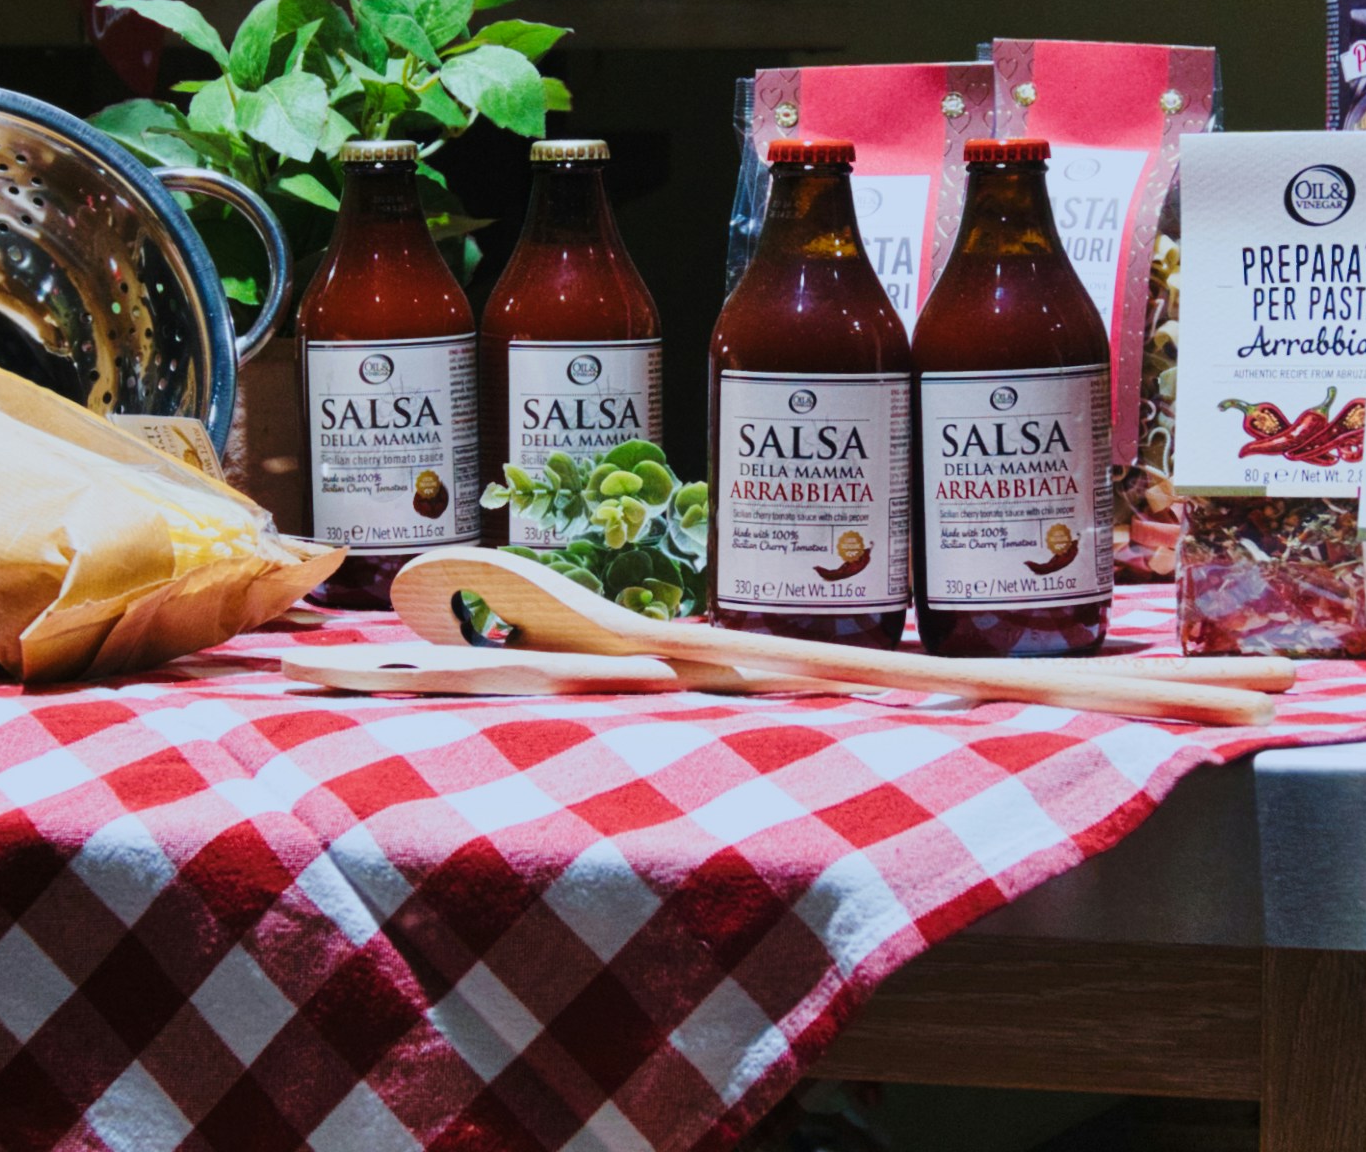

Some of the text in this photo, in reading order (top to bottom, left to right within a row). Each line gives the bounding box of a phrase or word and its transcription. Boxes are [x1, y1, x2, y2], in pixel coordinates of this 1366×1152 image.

[1295, 180, 1348, 201] OIL&
[1295, 200, 1344, 209] VINEGAR
[1051, 197, 1119, 230] STA
[1067, 237, 1113, 262] ORI
[1253, 288, 1296, 321] PER
[1233, 370, 1277, 378] AUTHENTIC
[1280, 370, 1308, 378] RECIPE
[1311, 370, 1333, 378] FROM
[321, 396, 441, 430] SALSA
[523, 396, 641, 430] SALSA
[321, 432, 441, 446] DELLA MAMMA
[522, 434, 570, 446] DELLA
[739, 424, 868, 460] SALSA
[942, 420, 1073, 458] SALSA
[321, 452, 443, 466] Sicilian cherry tomato sauce
[740, 462, 865, 478] DELLA MAMMA
[945, 460, 1069, 476] DELLA MAMMA
[357, 473, 381, 482] 100%
[1245, 469, 1259, 482] 80
[1263, 472, 1270, 484] g
[1301, 470, 1320, 482] Net
[1325, 470, 1343, 482] Wt.
[347, 484, 372, 495] Cherry
[375, 483, 408, 493] Tomatoes
[730, 480, 875, 502] ARRABBIATA
[936, 476, 1079, 500] ARRABBIATA
[753, 510, 771, 521] cherry
[772, 511, 795, 520] tomato
[797, 512, 817, 521] sauce
[819, 511, 833, 521] with
[849, 512, 869, 523] pepper
[961, 510, 979, 520] cherry
[979, 510, 1004, 518] tomato
[1005, 510, 1025, 518] sauce
[1027, 508, 1041, 516] with
[1057, 506, 1075, 516] pepper
[327, 527, 341, 540] 330
[373, 526, 391, 540] Net
[393, 526, 409, 538] Wt.
[413, 524, 433, 538] 11.6
[435, 526, 445, 536] oz
[733, 528, 799, 540] Made with 100%
[941, 527, 1009, 538] Made with 100%
[759, 542, 788, 554] Cherry
[791, 542, 828, 552] Tomatoes
[969, 539, 997, 551] Cherry
[1001, 538, 1037, 548] Tomatoes
[735, 580, 751, 594] 330
[753, 585, 761, 599] g
[786, 584, 805, 597] Net
[808, 584, 827, 598] Wt.
[831, 584, 853, 598] 11.6
[855, 588, 866, 598] oz
[945, 580, 963, 594] 330
[965, 584, 972, 598] g
[997, 579, 1019, 594] Net
[1020, 578, 1039, 592] Wt.
[1043, 576, 1063, 590] 11.6
[1065, 578, 1077, 589] oz
